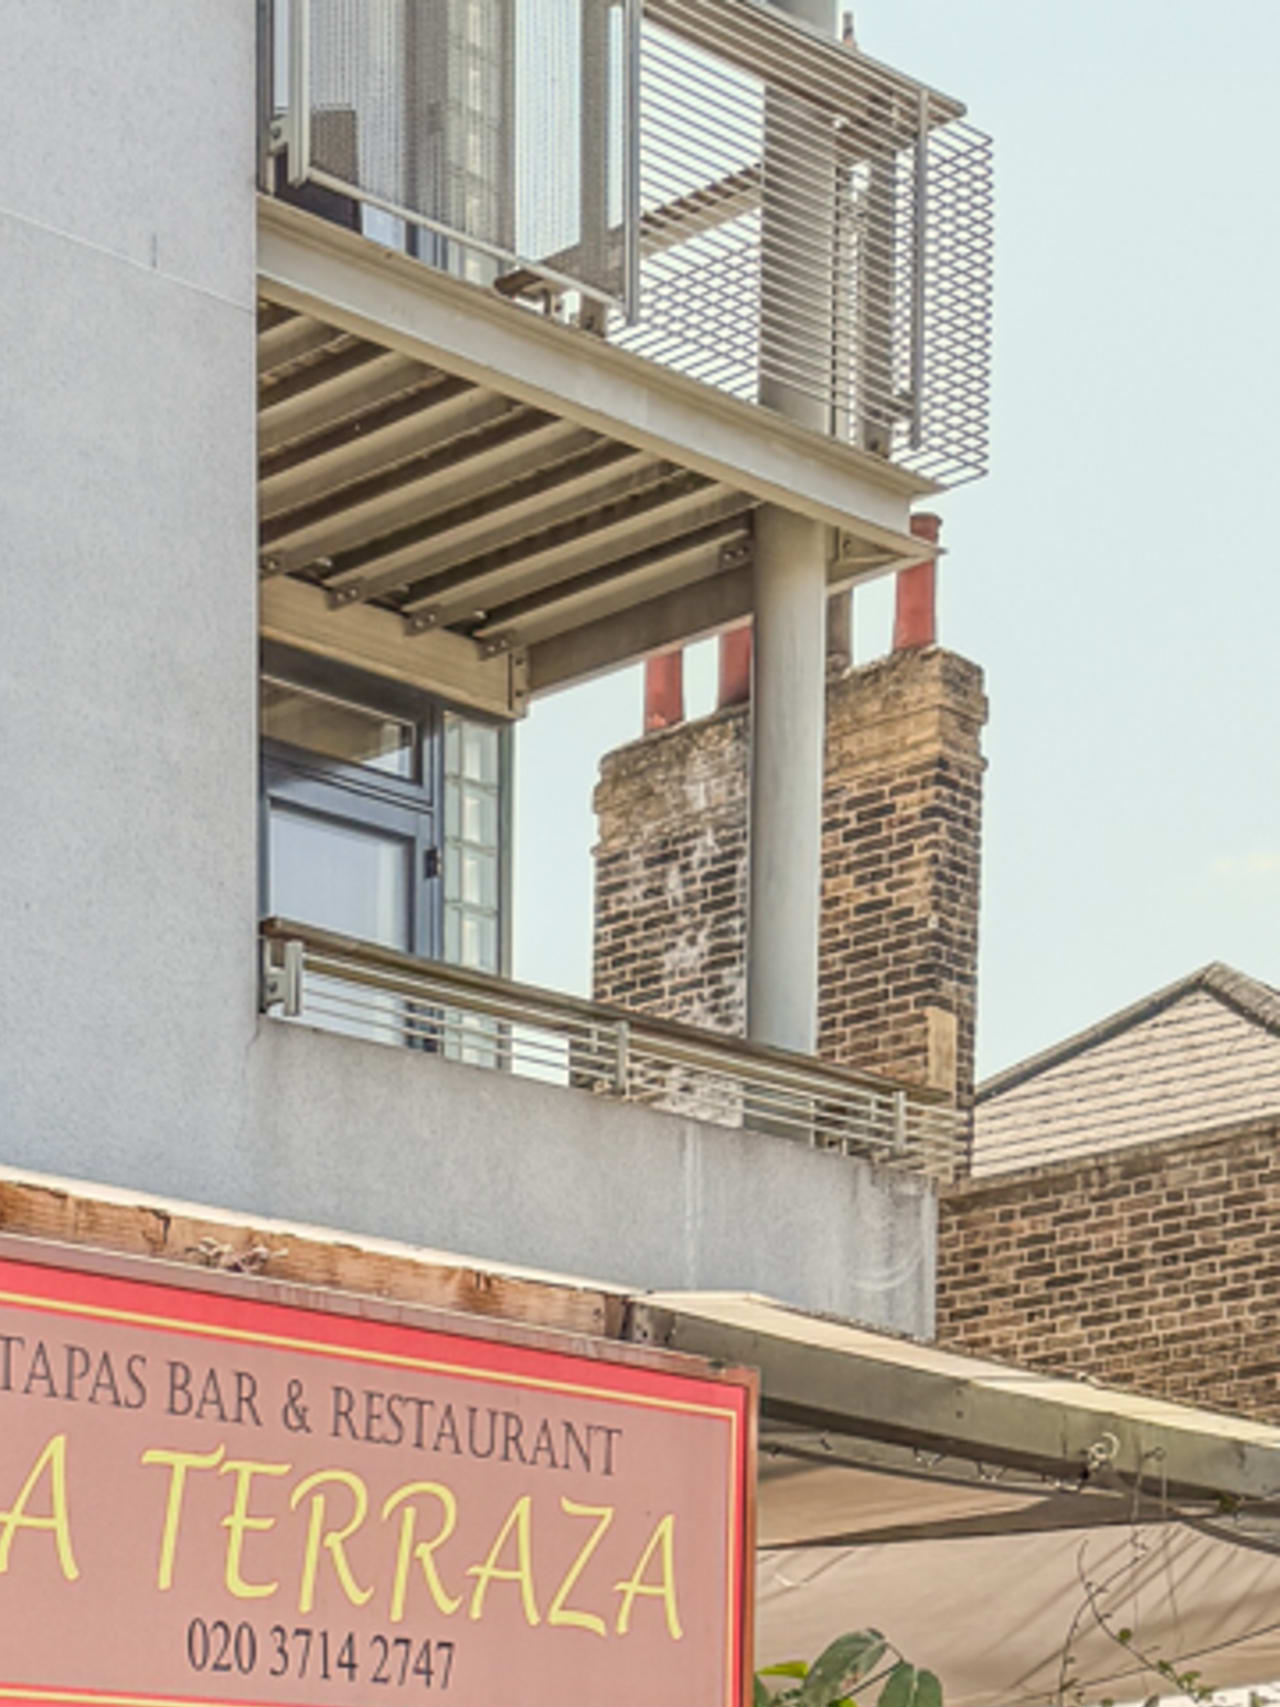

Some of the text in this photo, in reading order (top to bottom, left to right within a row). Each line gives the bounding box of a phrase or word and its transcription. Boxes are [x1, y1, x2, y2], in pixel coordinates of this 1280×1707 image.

[165, 1360, 262, 1426] BAR
[282, 1378, 311, 1431] &
[331, 1384, 622, 1476] RESTAURANT
[142, 1444, 682, 1639] TERRAZA
[187, 1617, 454, 1689] 020 3714 2747
